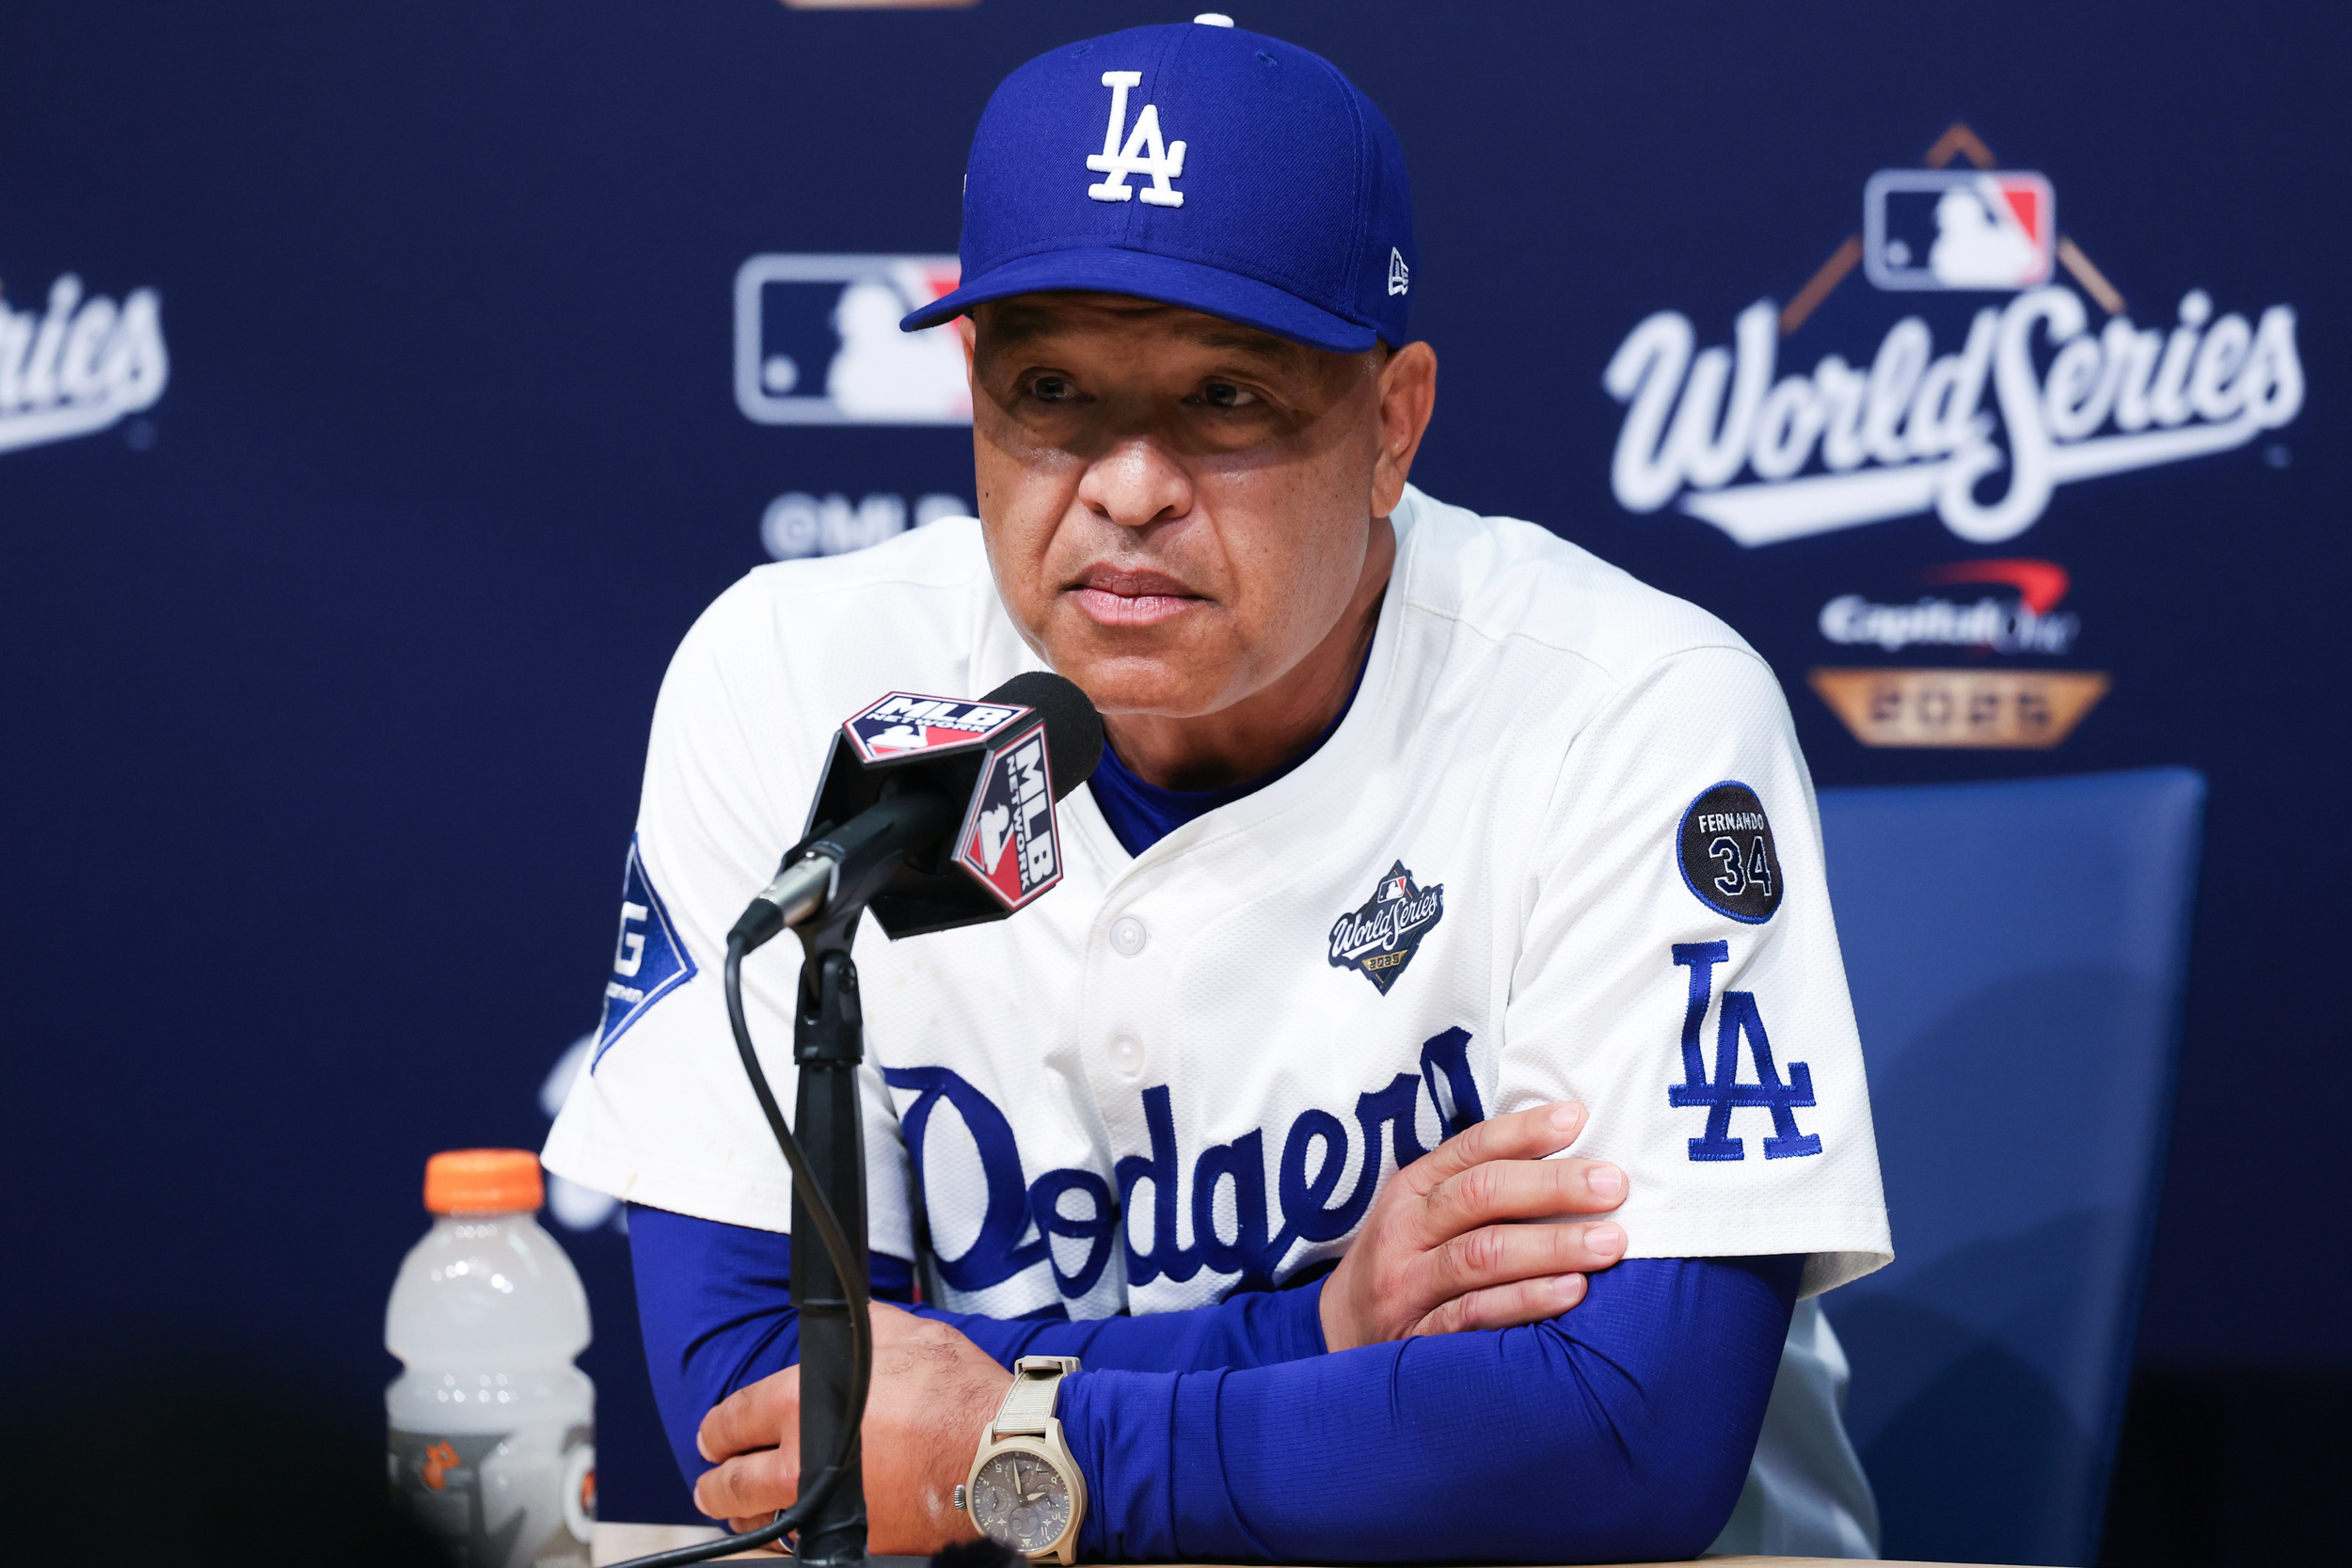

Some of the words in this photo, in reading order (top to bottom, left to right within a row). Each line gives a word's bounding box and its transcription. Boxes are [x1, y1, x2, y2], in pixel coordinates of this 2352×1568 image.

[1087, 71, 1187, 208] LA
[1602, 297, 2002, 517] World
[1933, 285, 2305, 544] Series
[866, 712, 990, 734] NETWORK
[882, 697, 1013, 726] MLB
[1007, 753, 1030, 891] NETWORK
[1014, 739, 1055, 883] MLB
[1698, 812, 1765, 833] FERNANDO
[1708, 835, 1772, 897] 34
[1331, 904, 1395, 958] World
[1382, 891, 1438, 952] Series
[1368, 953, 1401, 970] 2025
[1668, 940, 1823, 1162] LA
